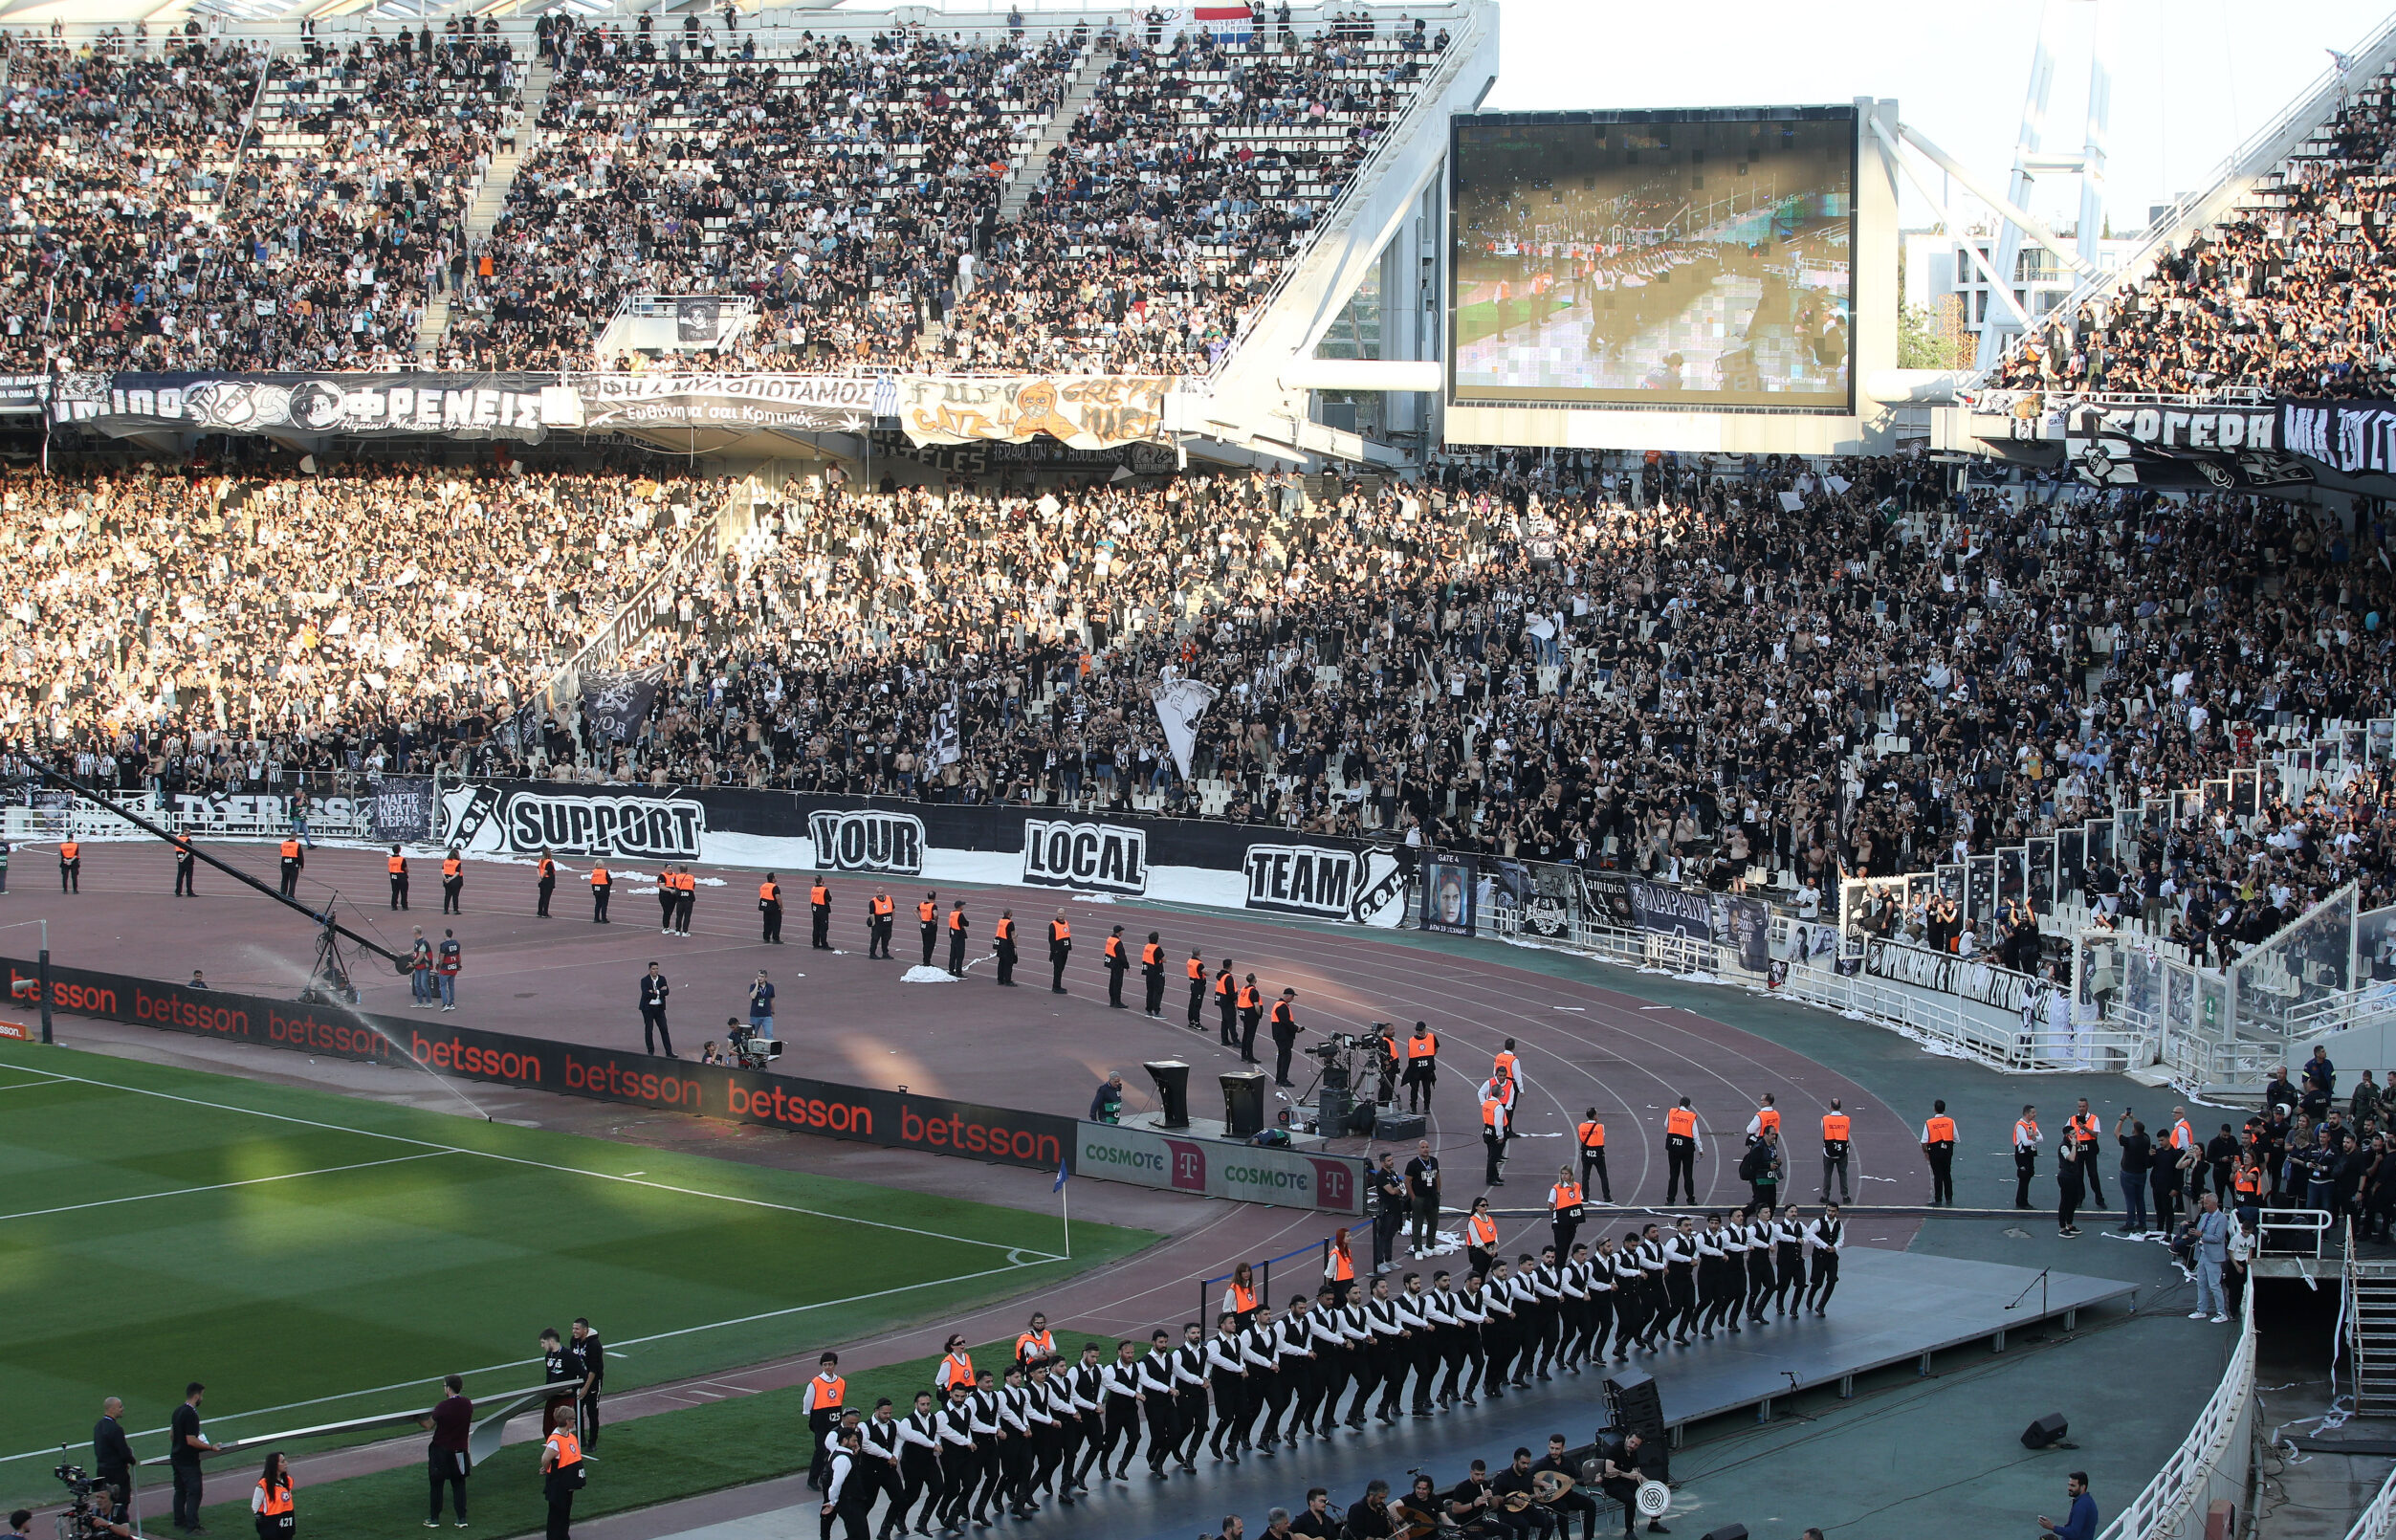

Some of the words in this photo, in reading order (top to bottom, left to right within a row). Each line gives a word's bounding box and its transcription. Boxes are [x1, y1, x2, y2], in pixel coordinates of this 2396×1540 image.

[341, 419, 389, 432] Against
[392, 419, 439, 431] Modern
[345, 387, 542, 429] ΦΡΕΝΕΙΣ
[626, 403, 686, 421] Ευθύνη
[73, 799, 145, 815] SNAES
[379, 793, 419, 805] ΜΑΡΙΕ
[379, 804, 419, 816] ΚΡΑΤΑ
[511, 799, 702, 856] SUPPORT
[814, 813, 922, 869] YOUR
[1027, 821, 1144, 886] LOCAL
[1438, 854, 1454, 863] GATE
[1250, 847, 1354, 908] TEAM
[1738, 932, 1752, 943] GATE
[11, 968, 117, 1015] besson
[136, 988, 249, 1036] betsson
[270, 1010, 388, 1057] betsson
[411, 1030, 540, 1082] betsson
[565, 1054, 702, 1108] betsson
[728, 1078, 872, 1135] betsson
[901, 1105, 1061, 1162] betsson
[1086, 1144, 1164, 1171] COSMOTE
[1179, 1153, 1198, 1179] T
[1224, 1165, 1308, 1191] COSMOTE
[1325, 1171, 1344, 1199] T
[1570, 1209, 1582, 1218] 428
